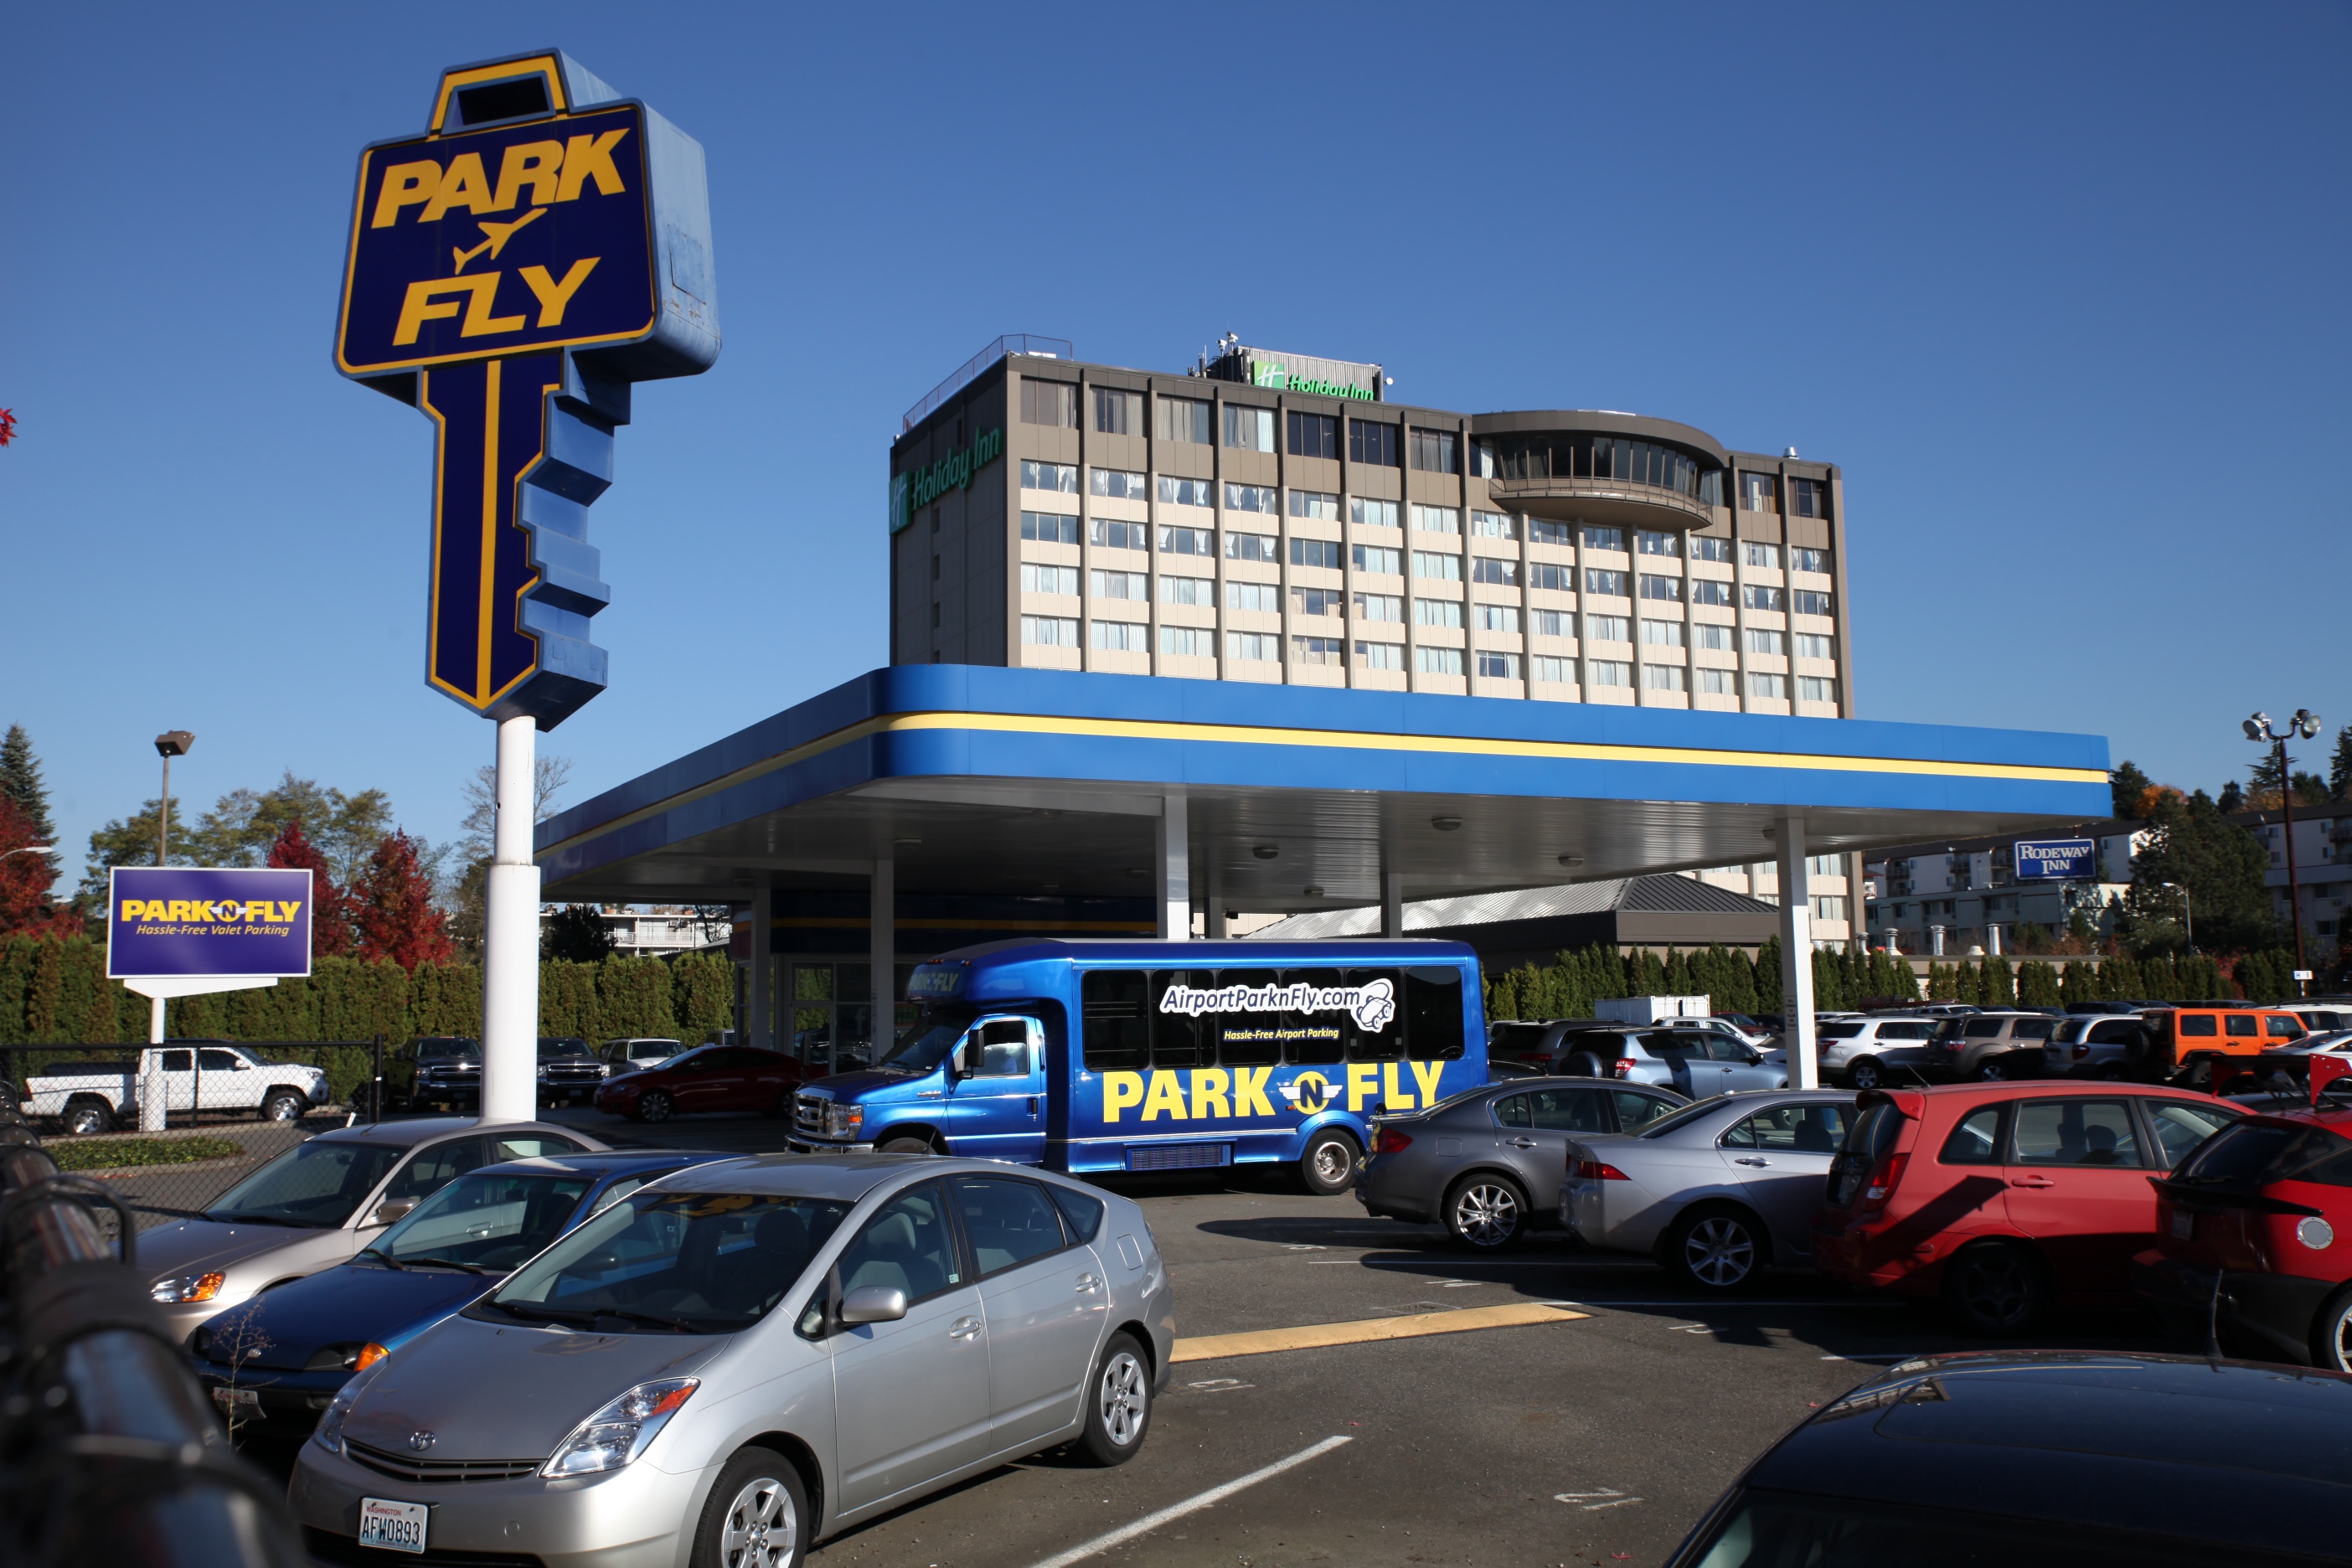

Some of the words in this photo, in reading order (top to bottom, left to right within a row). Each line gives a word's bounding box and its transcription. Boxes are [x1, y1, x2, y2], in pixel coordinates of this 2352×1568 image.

[371, 128, 630, 229] PARK
[392, 257, 601, 346] FLY
[1289, 374, 1349, 397] Holiday
[1350, 383, 1374, 401] Inn
[913, 448, 970, 510] Holiday
[974, 426, 999, 469] Inn
[2041, 859, 2070, 874] INN
[121, 900, 215, 921] PARK
[245, 900, 302, 922] FLY
[137, 925, 207, 935] Hassle-Free
[211, 925, 242, 935] Valet
[244, 925, 289, 936] Parking
[934, 973, 958, 992] FLY
[1164, 987, 1359, 1011] AirportParknFly.com
[1224, 1029, 1273, 1040] Hassle-Free
[1276, 1029, 1305, 1040] Airport
[1308, 1029, 1338, 1039] Parking
[1103, 1065, 1276, 1123] PARK
[1300, 1079, 1323, 1108] N
[1347, 1060, 1445, 1112] FLY
[366, 1506, 401, 1516] WASHINGTON
[362, 1515, 420, 1544] AFW0893
